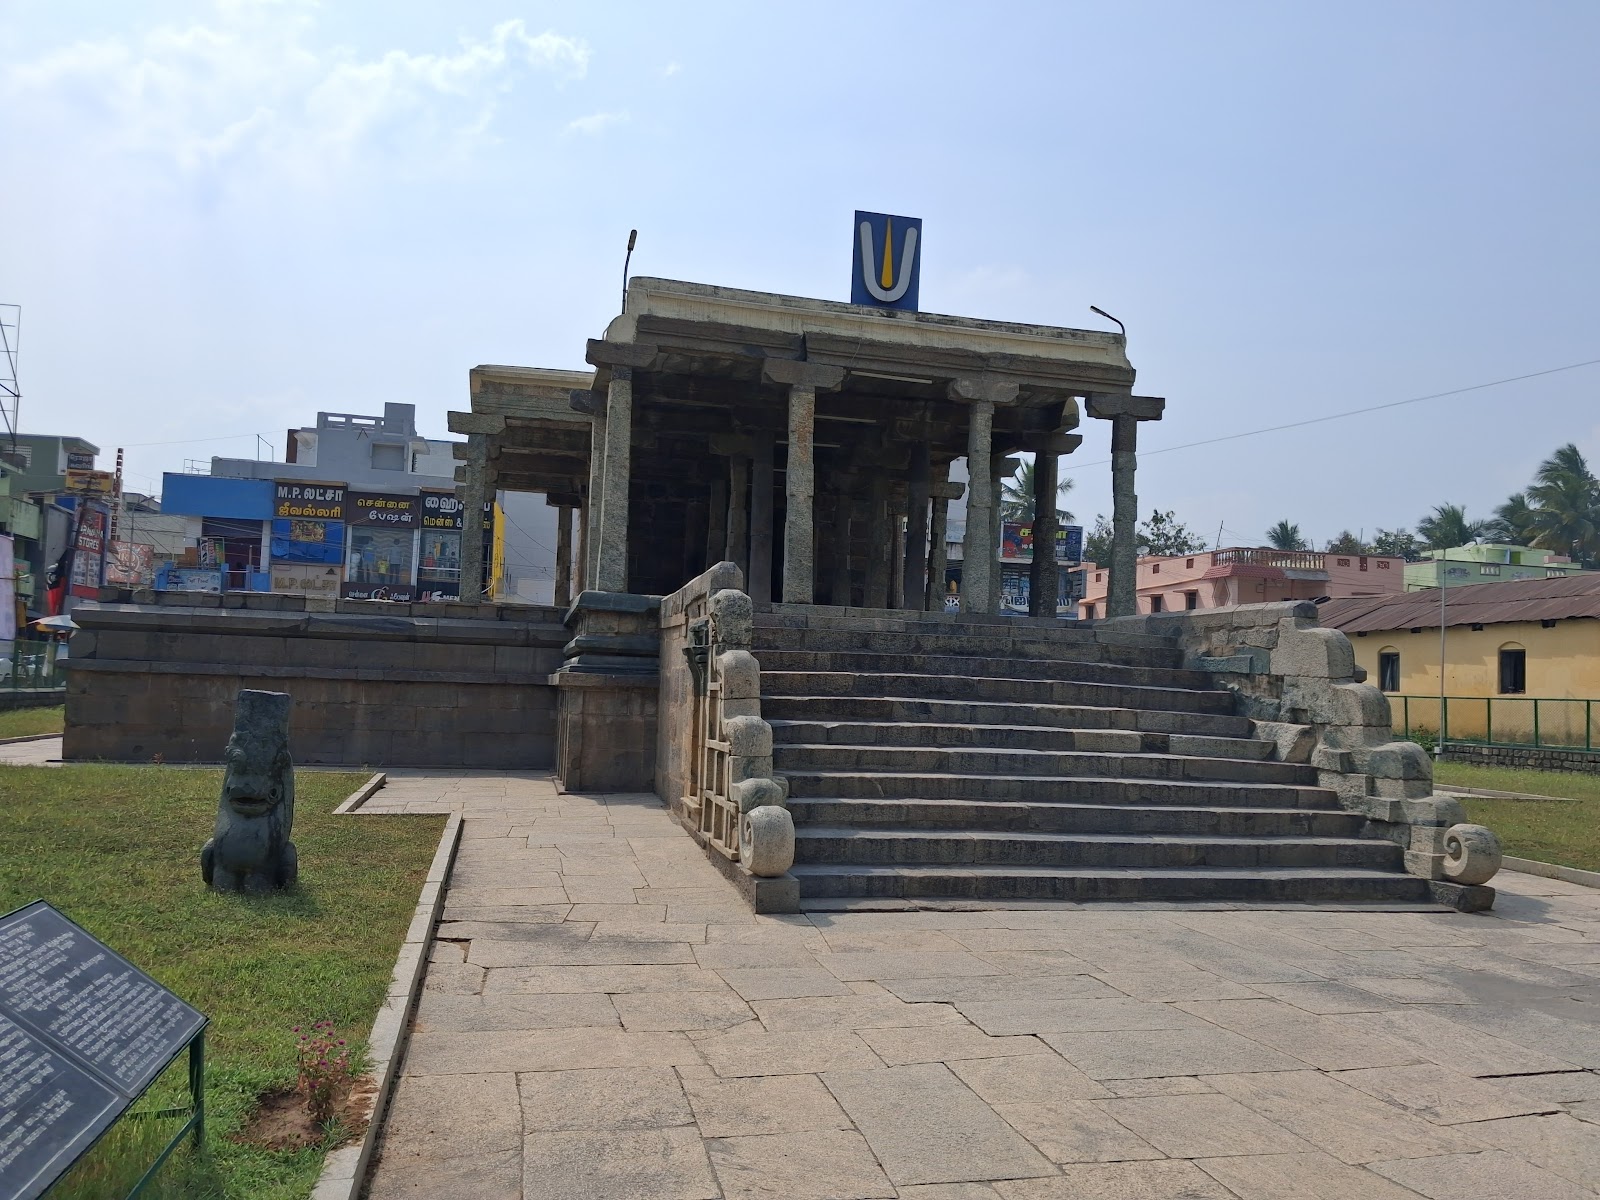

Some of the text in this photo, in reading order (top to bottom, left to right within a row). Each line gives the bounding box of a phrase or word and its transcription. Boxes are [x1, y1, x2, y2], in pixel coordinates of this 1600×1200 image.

[278, 486, 344, 501] M.P. லட்சா
[278, 502, 341, 518] ஜீவல்லரி
[357, 498, 411, 510] சென்னை
[369, 510, 413, 523] பேஷன்
[423, 515, 463, 528] மென்ஸ் &
[78, 536, 100, 551] STORES
